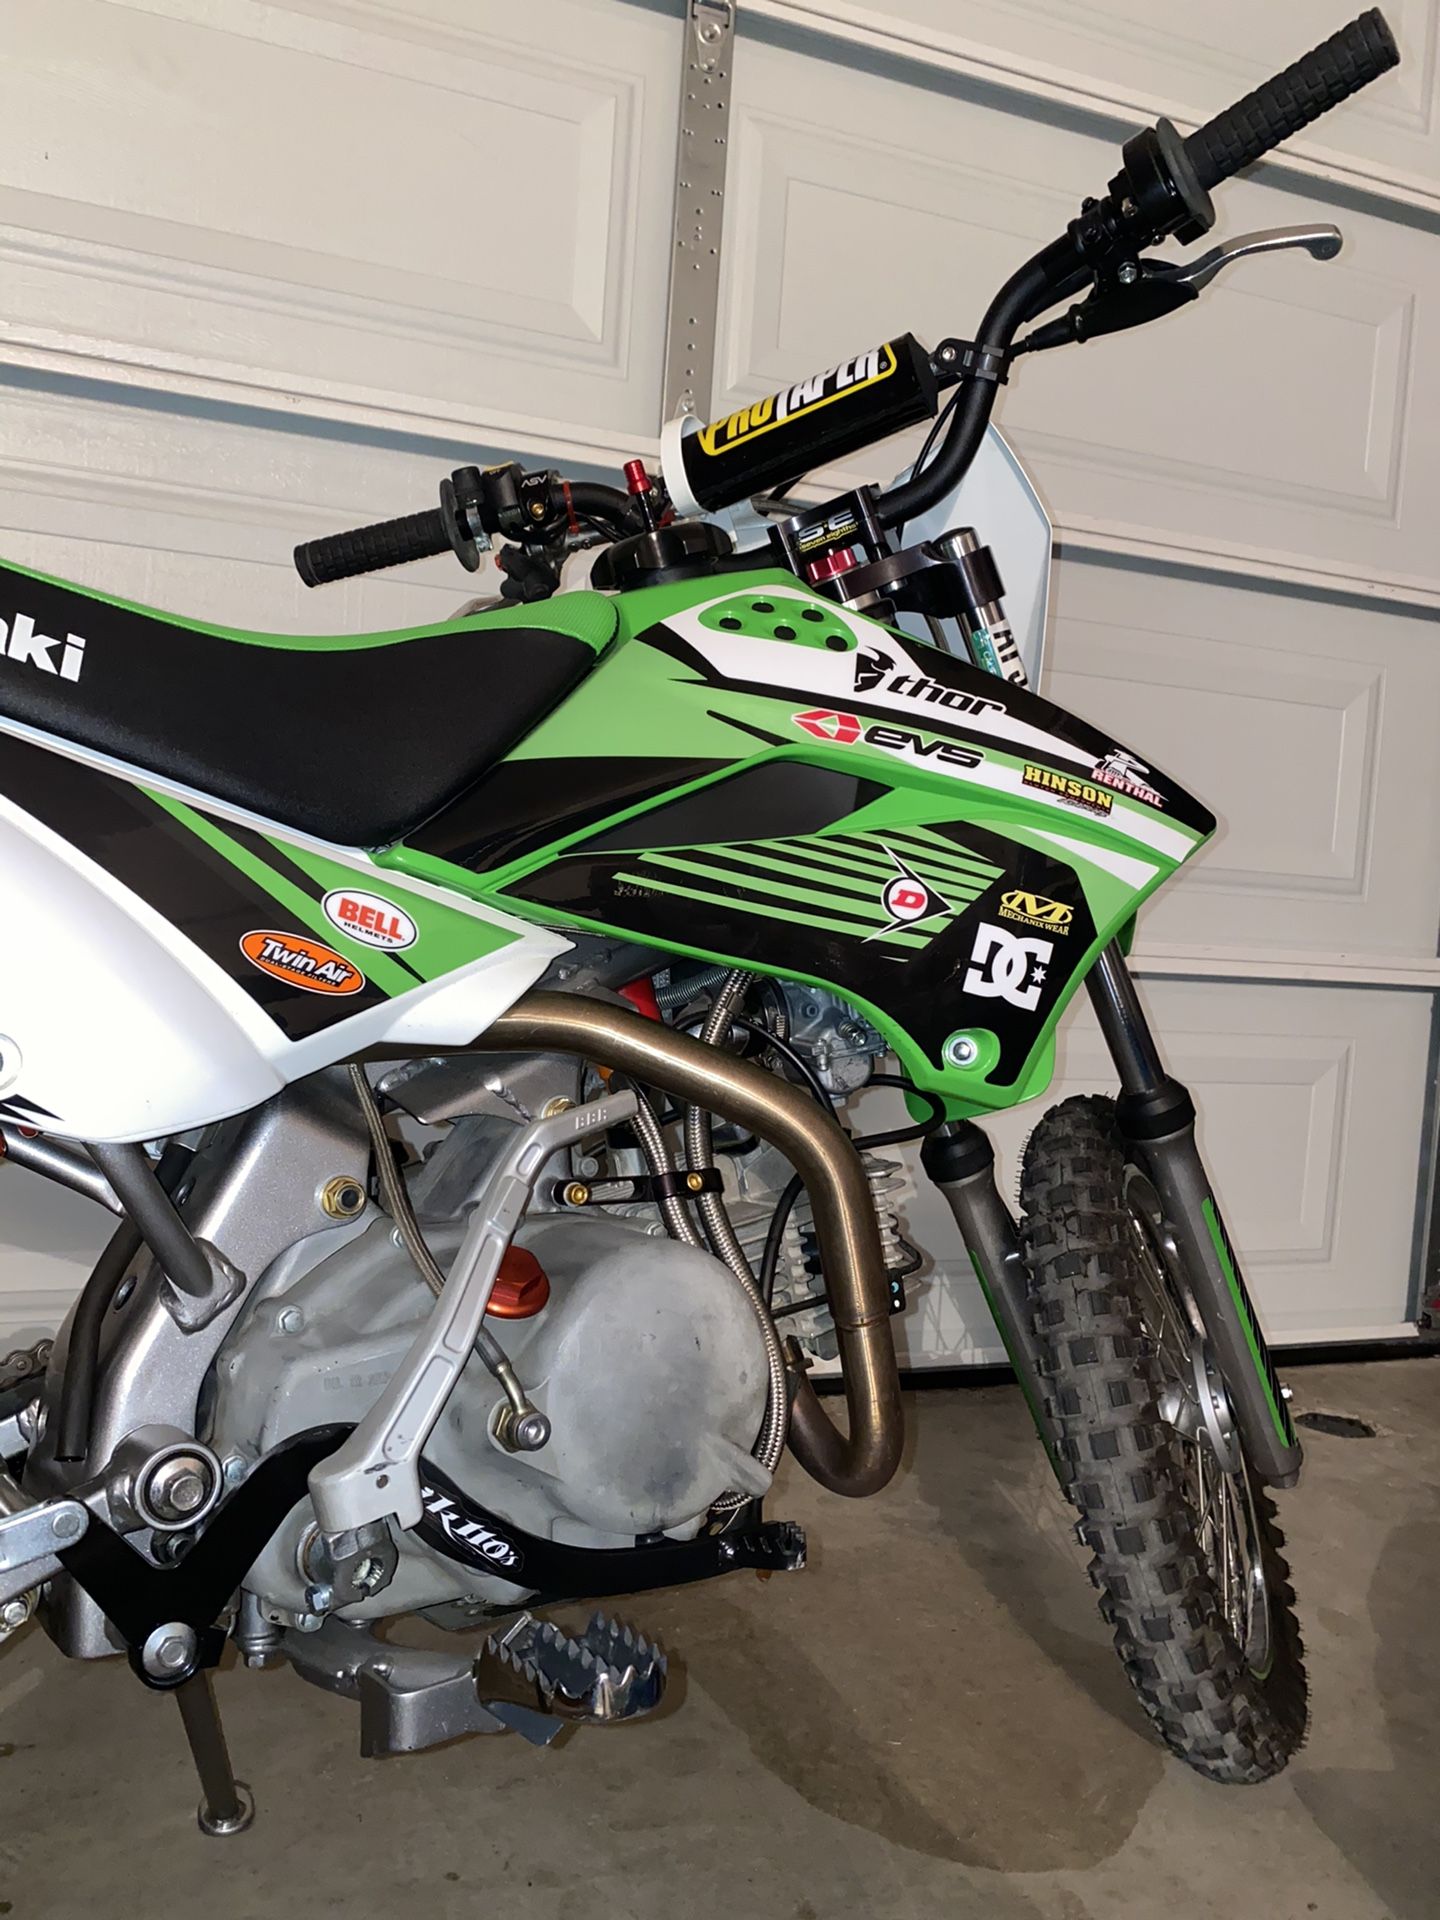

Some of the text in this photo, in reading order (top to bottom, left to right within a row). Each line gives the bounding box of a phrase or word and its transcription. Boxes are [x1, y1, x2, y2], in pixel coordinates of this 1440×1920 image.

[521, 474, 547, 488] ASV
[887, 675, 1003, 716] thor
[1024, 765, 1113, 808] HINSON
[1091, 769, 1163, 808] RENTHAL
[338, 898, 402, 940] BELL
[344, 922, 393, 943] HELMETS
[998, 905, 1069, 936] MECHANIX WEAR
[262, 939, 353, 983] Twin Air
[962, 922, 1054, 1012] DC
